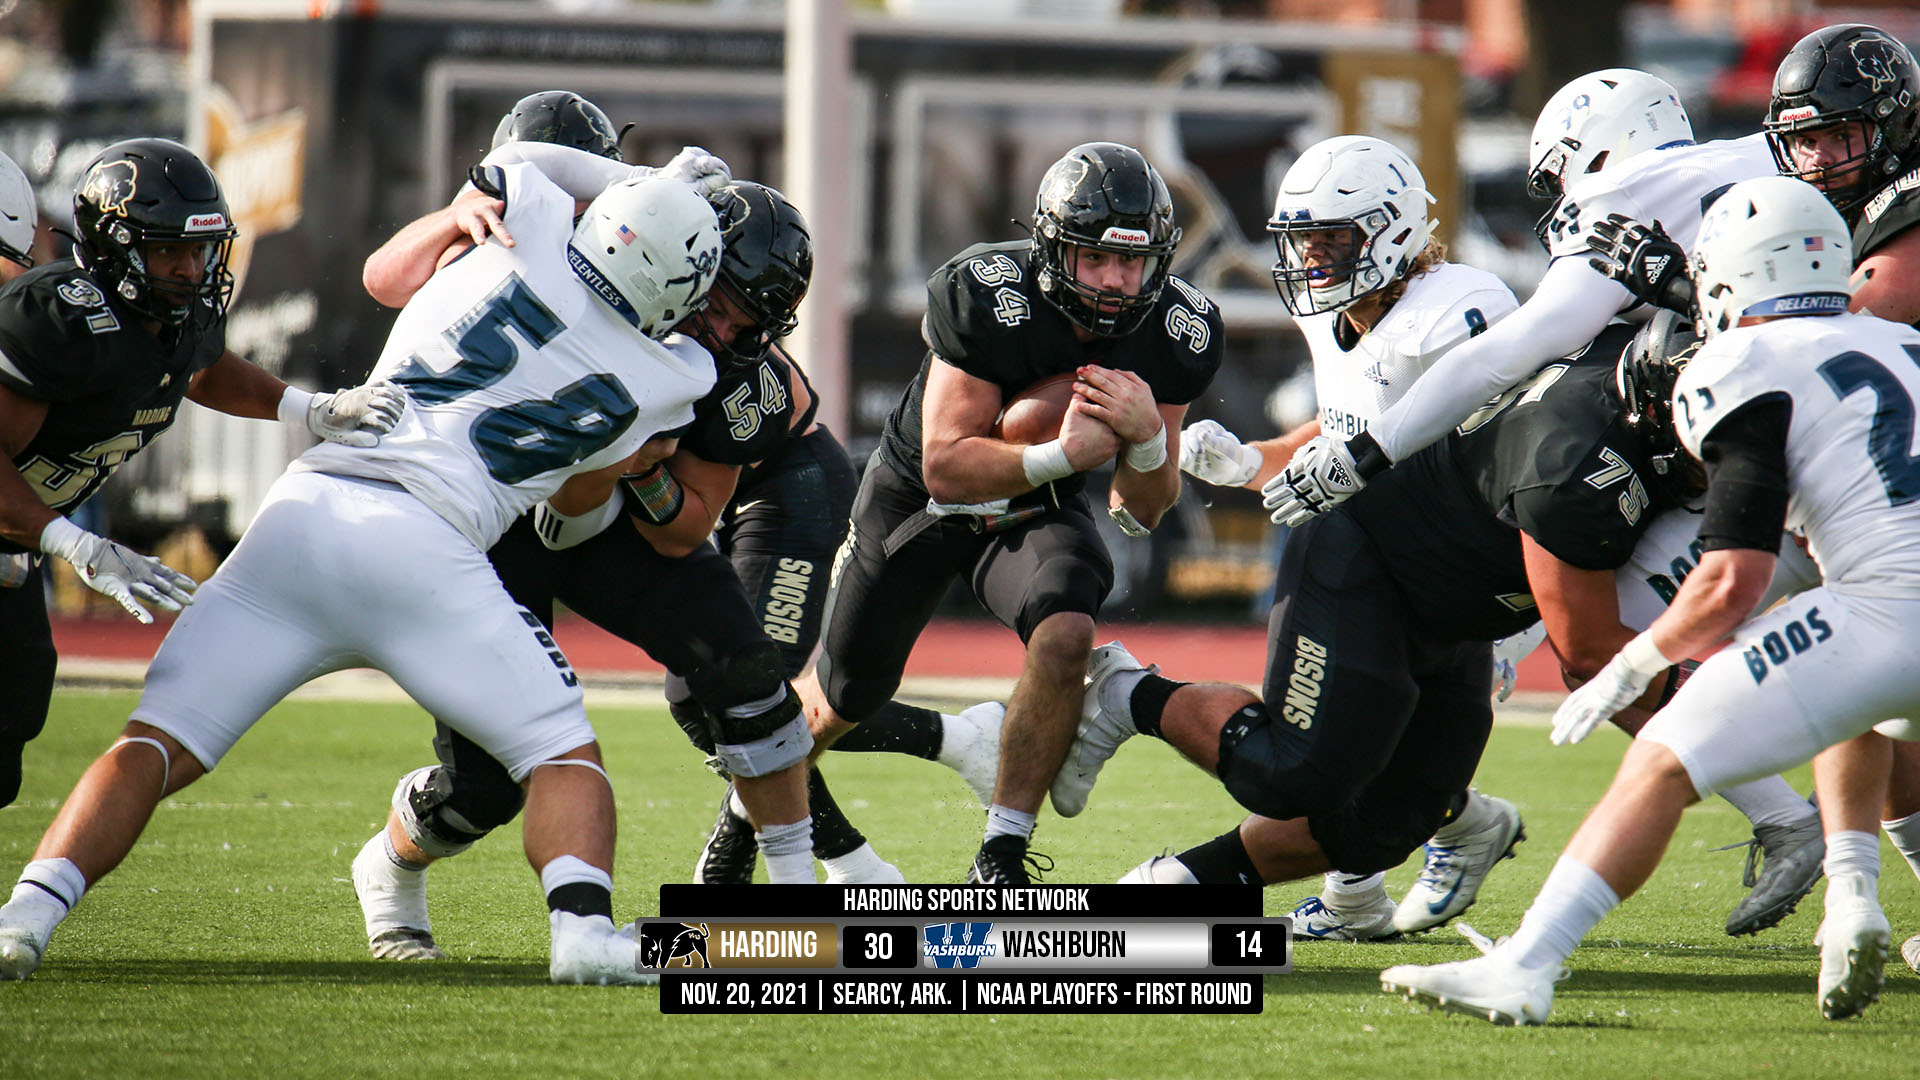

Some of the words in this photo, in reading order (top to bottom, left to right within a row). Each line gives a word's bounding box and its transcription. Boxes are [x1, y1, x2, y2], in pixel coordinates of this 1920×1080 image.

[192, 216, 223, 227] Riddell
[568, 249, 623, 307] RELENTLESS
[969, 254, 1032, 328] 34
[1649, 253, 1672, 285] adidas
[1773, 295, 1847, 313] RELENTLESS
[1165, 273, 1215, 355] 34
[388, 269, 640, 485] 58
[721, 360, 787, 441] 54
[131, 405, 173, 427] HARDING
[1331, 456, 1353, 488] adidas
[1584, 446, 1650, 527] 75
[763, 557, 814, 645] BISONS
[1282, 634, 1328, 731] BISONS
